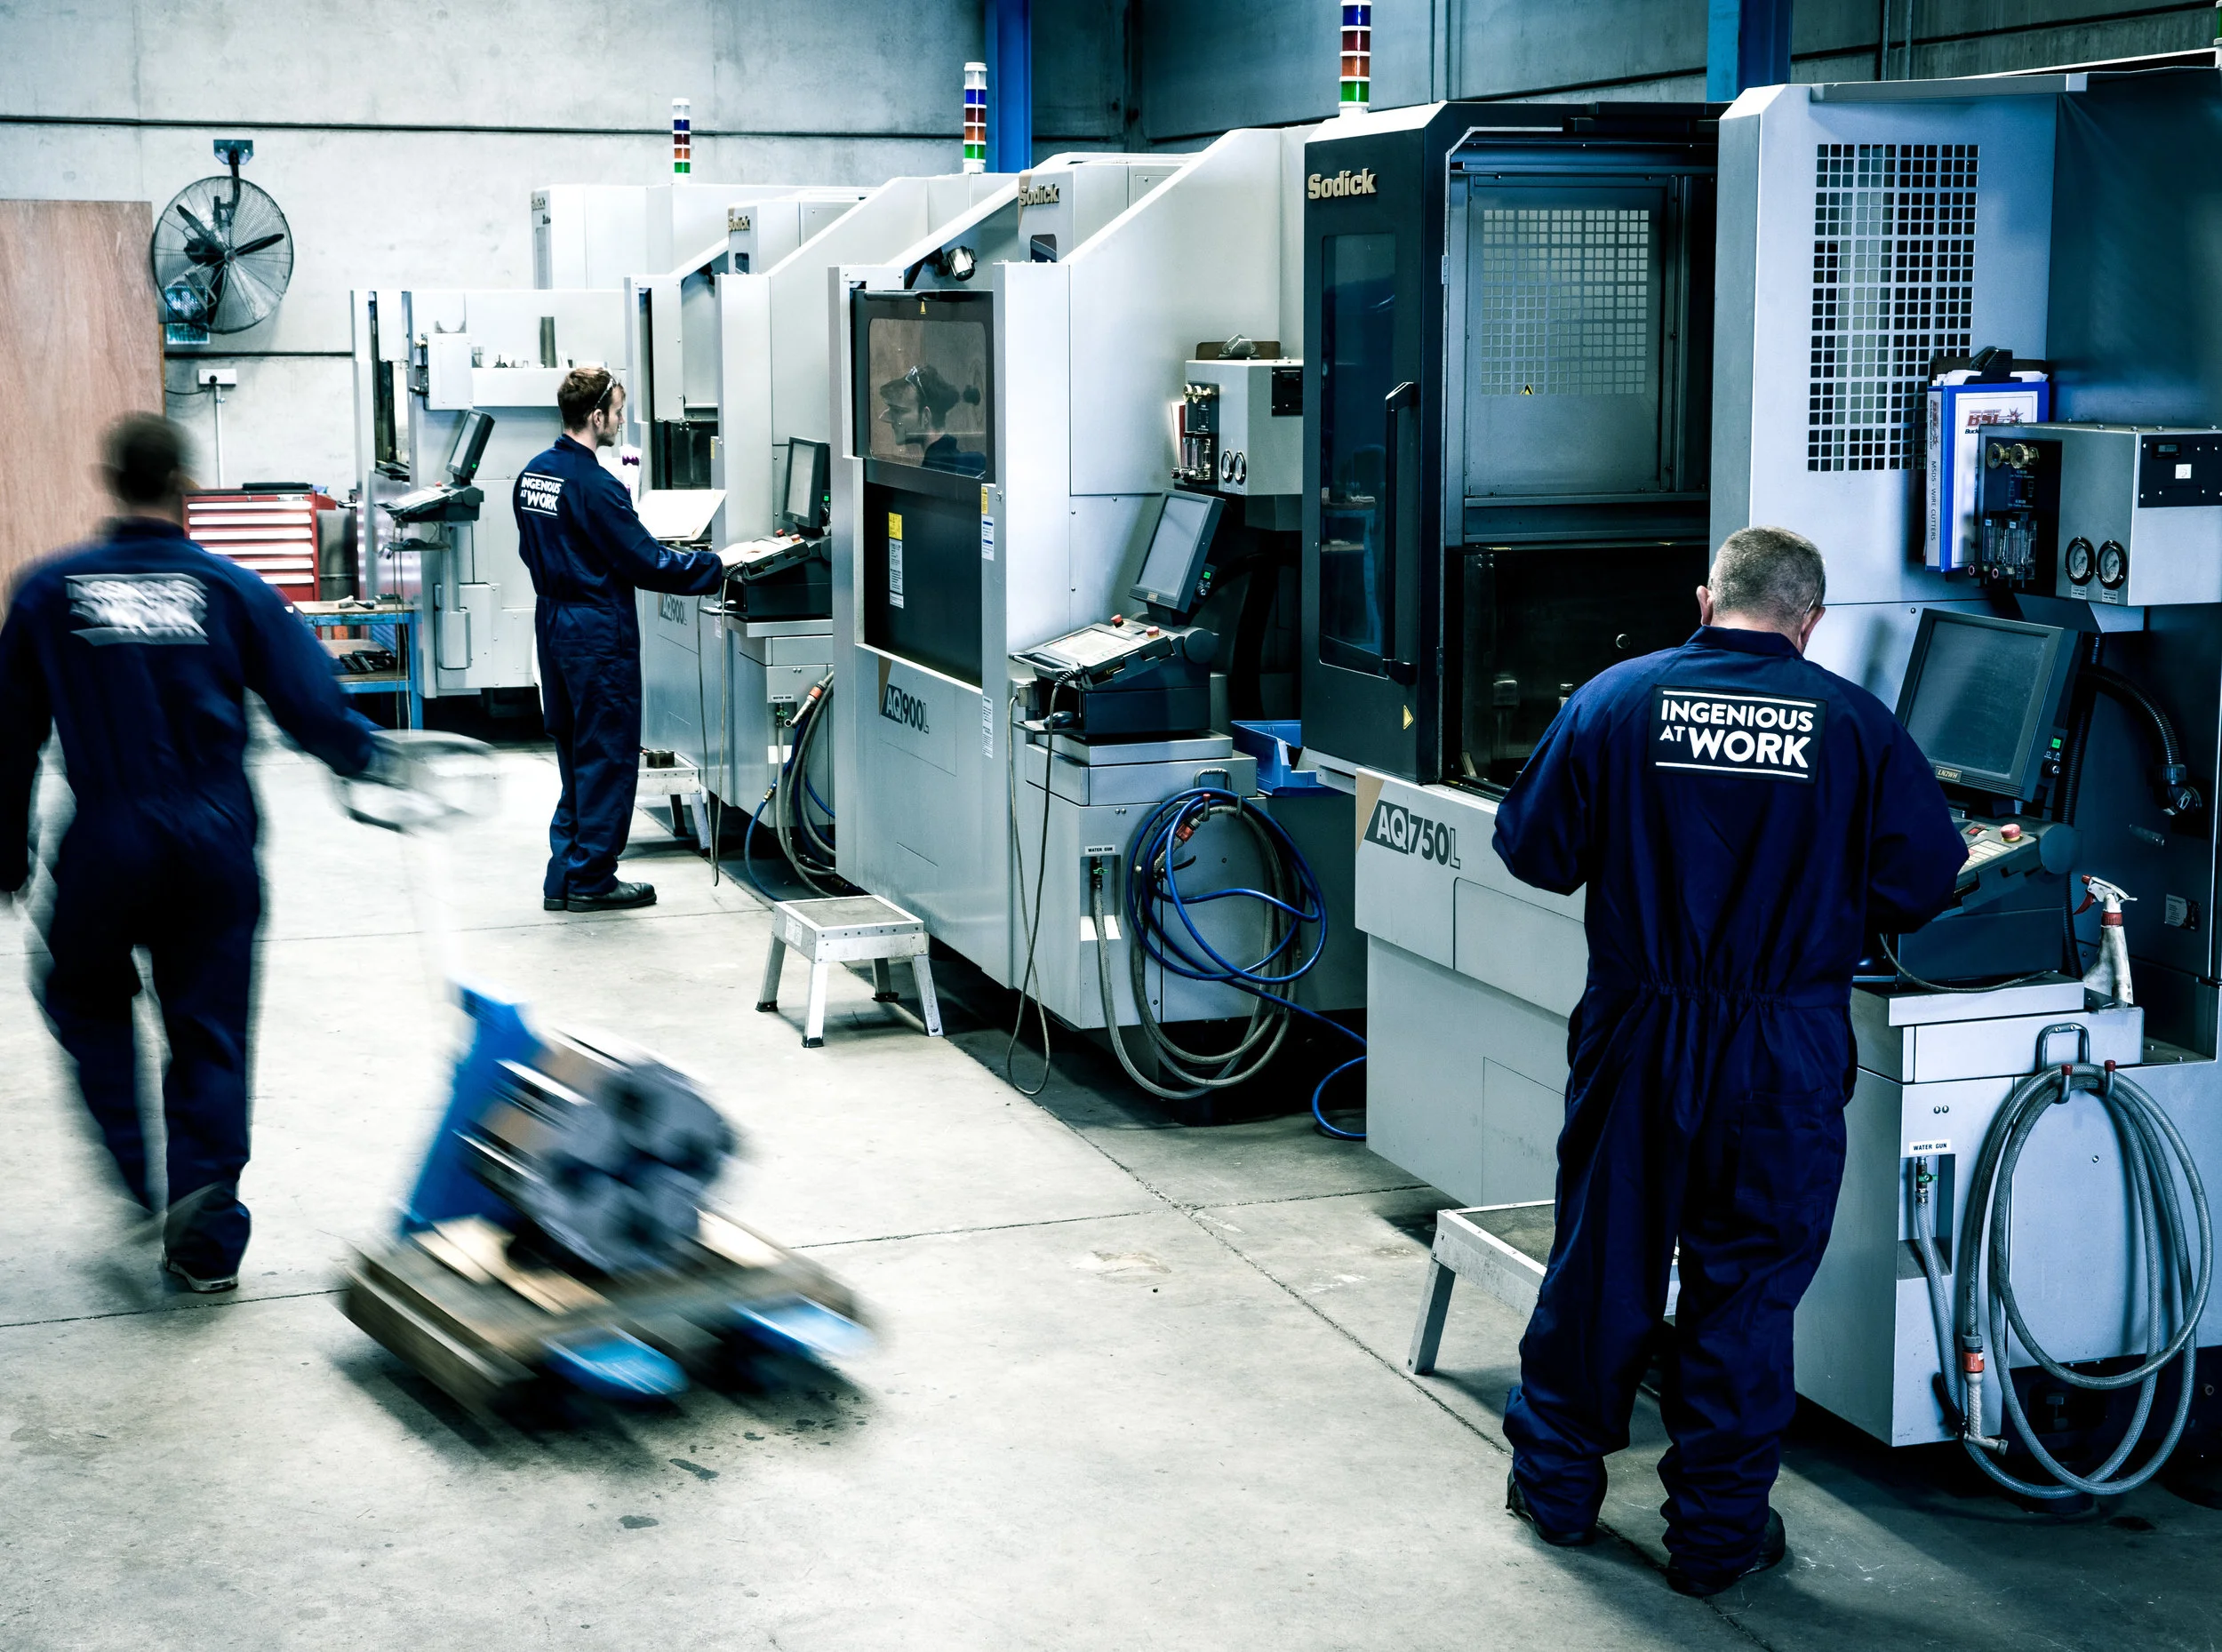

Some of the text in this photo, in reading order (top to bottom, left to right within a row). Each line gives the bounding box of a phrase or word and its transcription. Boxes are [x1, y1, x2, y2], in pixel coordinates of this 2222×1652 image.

[1019, 183, 1059, 206] Sodick
[1307, 168, 1377, 199] Sodick
[520, 489, 559, 512] AT WORK
[885, 686, 930, 735] AQ900L
[1661, 699, 1814, 732] INGENIOUS
[1659, 724, 1811, 769] AT WORK
[1375, 804, 1461, 870] AQ750L
